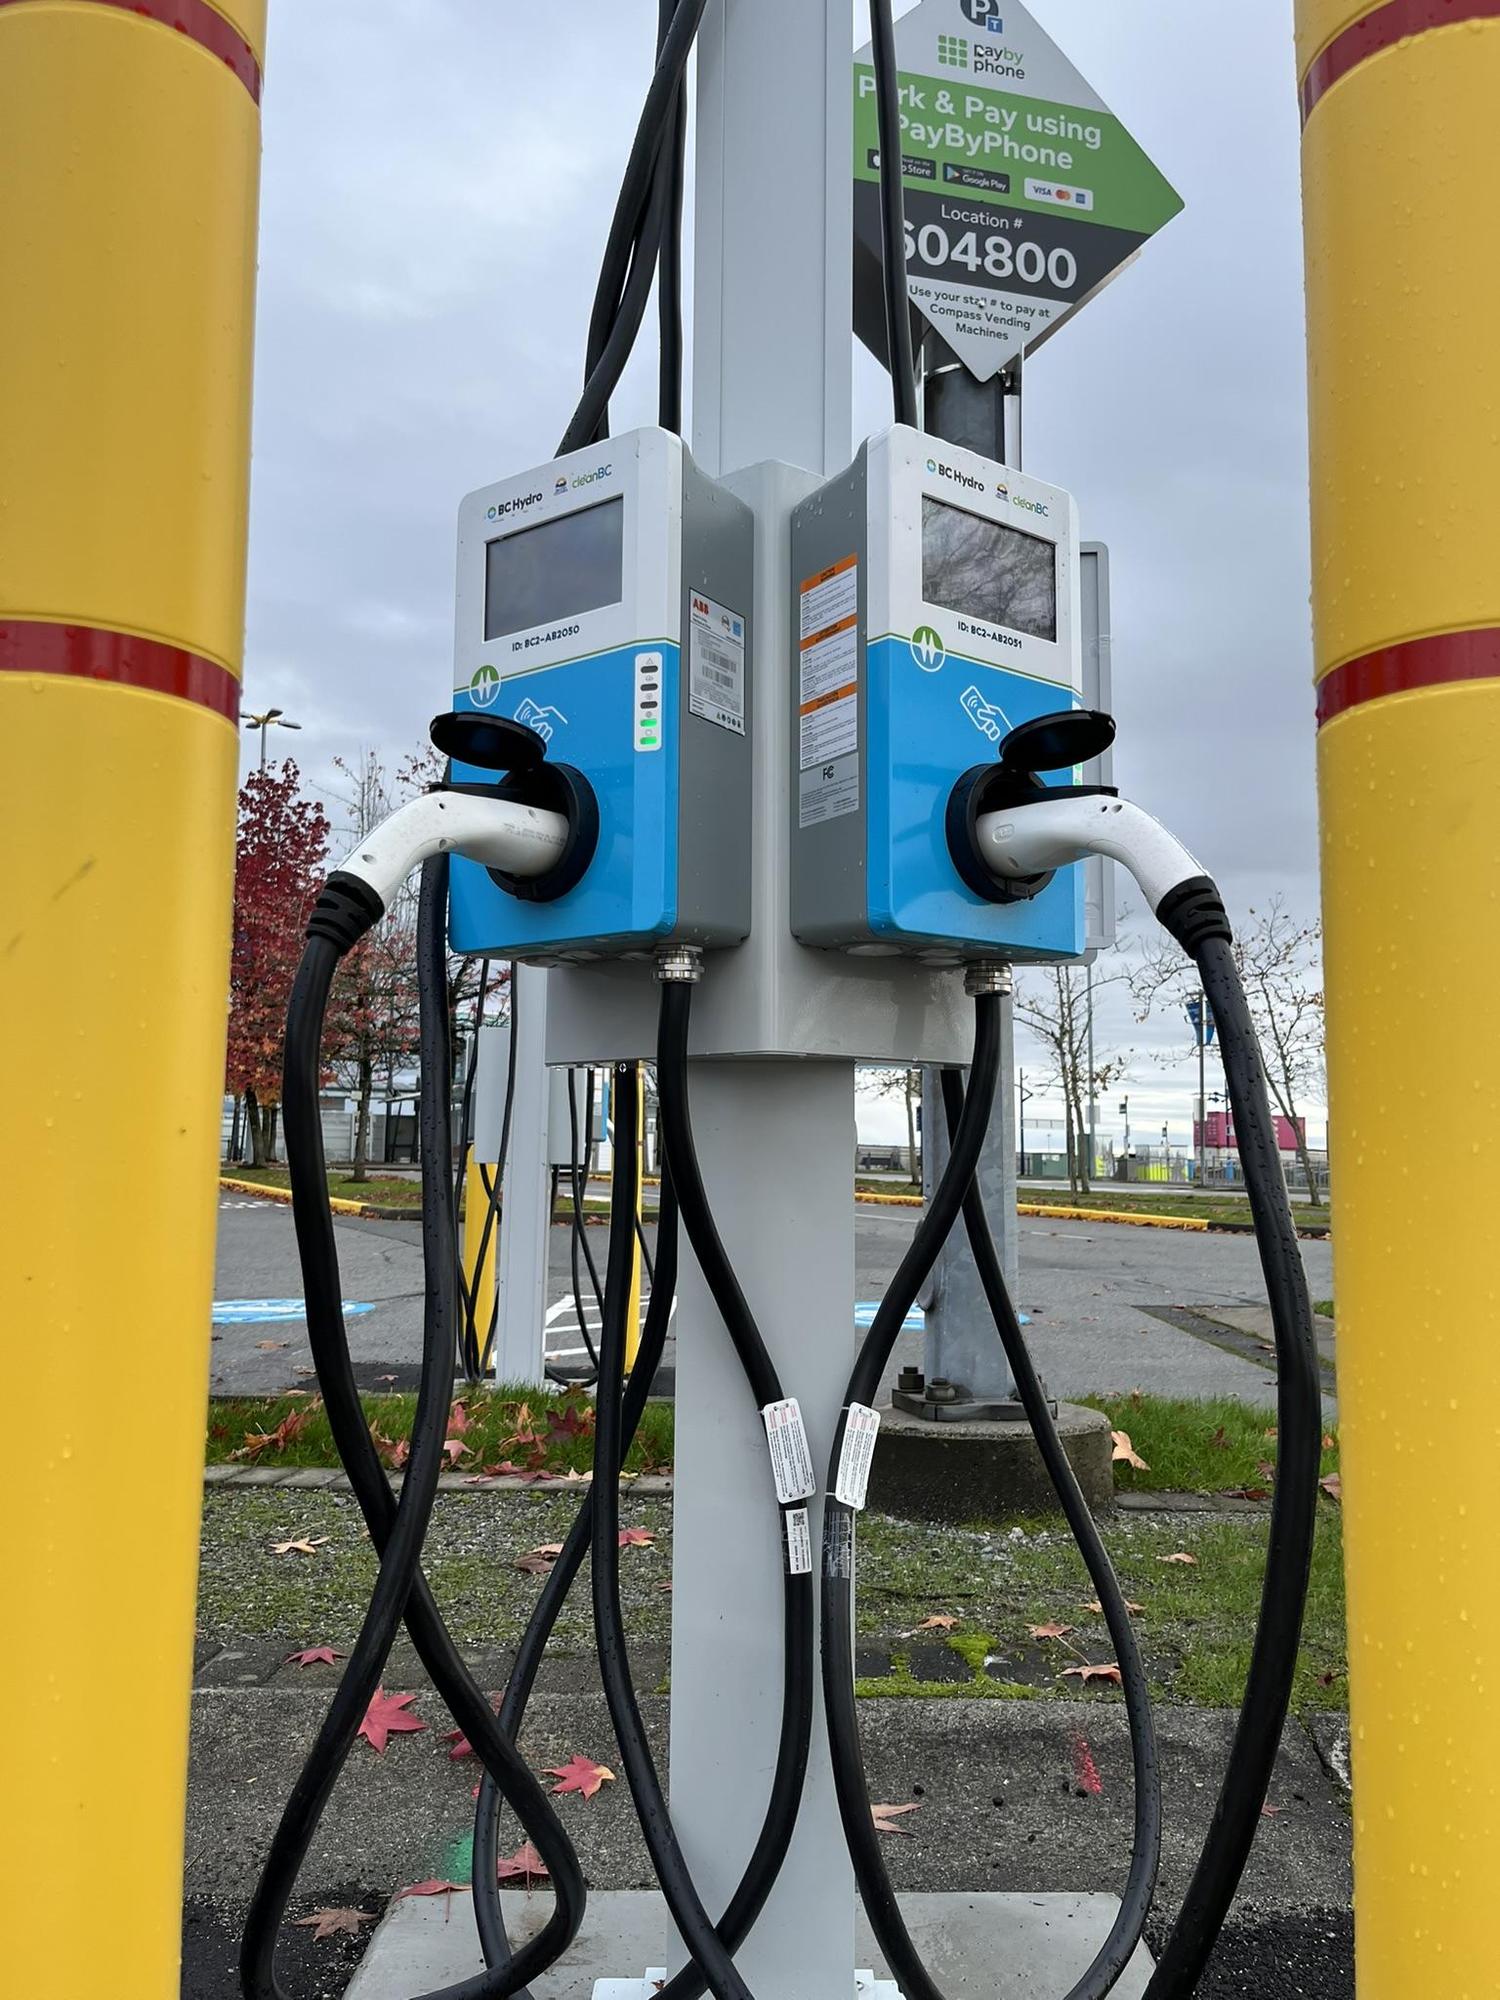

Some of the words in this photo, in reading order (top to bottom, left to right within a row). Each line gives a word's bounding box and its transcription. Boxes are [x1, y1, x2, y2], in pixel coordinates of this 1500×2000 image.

[991, 20, 1001, 30] T
[974, 44, 1024, 66] payby
[974, 60, 1025, 79] phone
[859, 75, 926, 109] Prk
[935, 90, 956, 116] &
[965, 96, 1018, 131] Pay
[1027, 115, 1102, 150] using
[907, 165, 931, 177] Store
[962, 174, 990, 187] Google
[991, 179, 1007, 192] Play
[1032, 186, 1052, 196] VISA
[941, 204, 1009, 229] Location
[1013, 218, 1024, 229] #
[909, 284, 932, 298] Use
[934, 290, 960, 303] your
[1000, 300, 1013, 311] to
[1015, 305, 1036, 318] pay
[1038, 308, 1050, 318] at
[930, 303, 982, 321] Compass
[985, 313, 1031, 331] Vending
[955, 323, 1009, 341] Machines
[938, 463, 953, 479] BC
[954, 470, 985, 492] Hydro
[498, 503, 512, 516] BC
[512, 492, 543, 511] Hydro
[692, 598, 709, 616] ABB
[511, 641, 523, 652] ID:
[524, 624, 580, 648] BC2-AB2050
[957, 621, 969, 633] ID:
[970, 624, 1022, 649] BC2-AB2051
